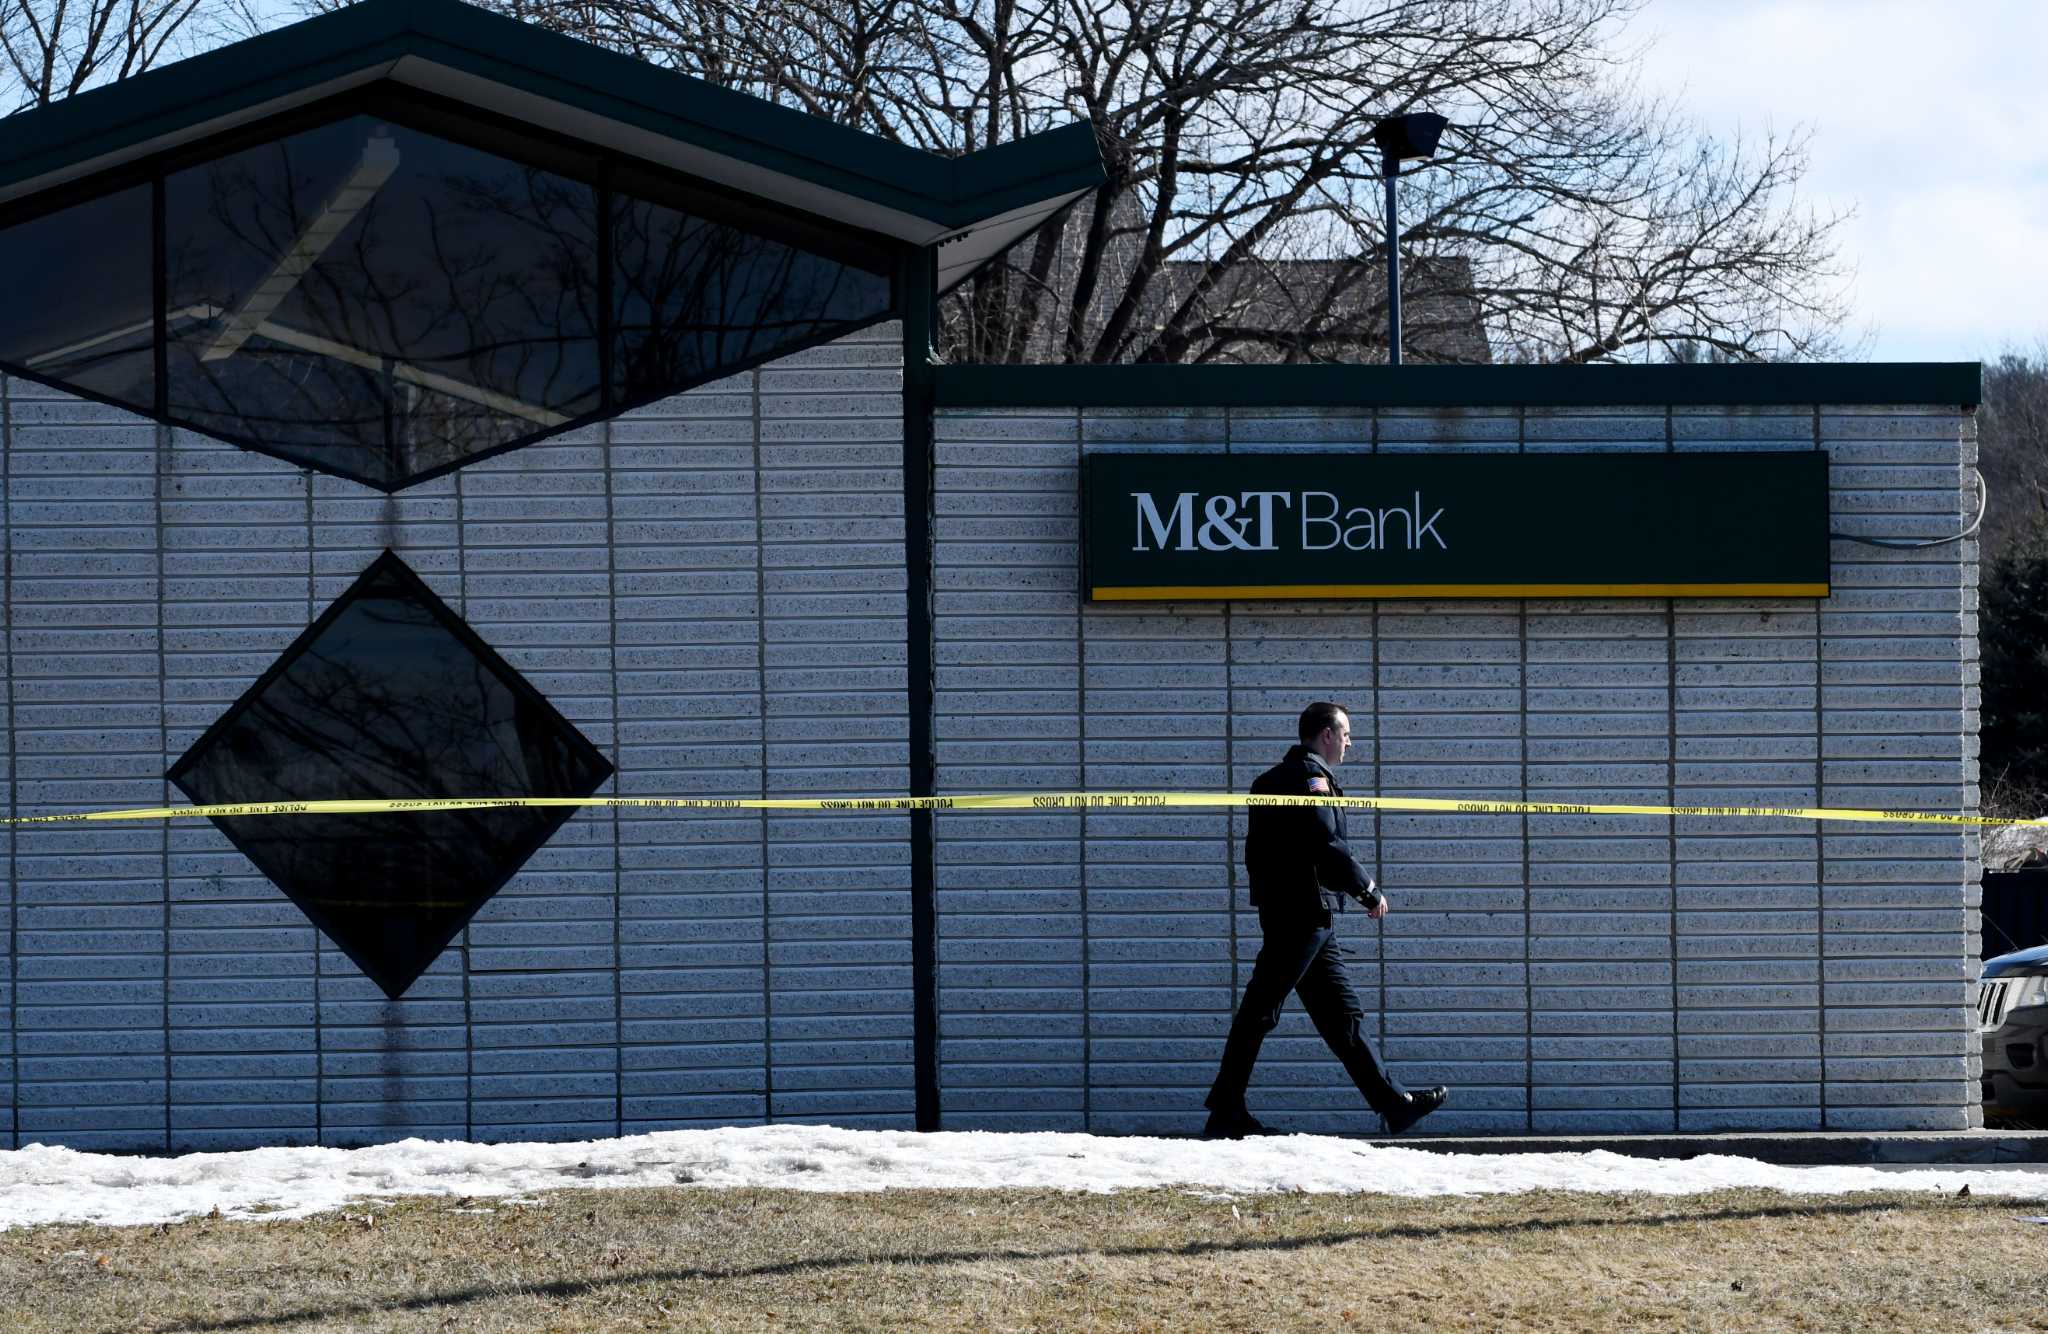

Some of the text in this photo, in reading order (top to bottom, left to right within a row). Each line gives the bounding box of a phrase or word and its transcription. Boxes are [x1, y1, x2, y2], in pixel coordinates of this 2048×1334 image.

[1130, 490, 1448, 552] M&T Bank
[857, 800, 875, 808] NOT
[878, 800, 890, 808] DO
[896, 799, 915, 808] LINE
[919, 799, 953, 808] POLICE
[1033, 796, 1166, 808] POLICE LINE DO NOT CROSS
